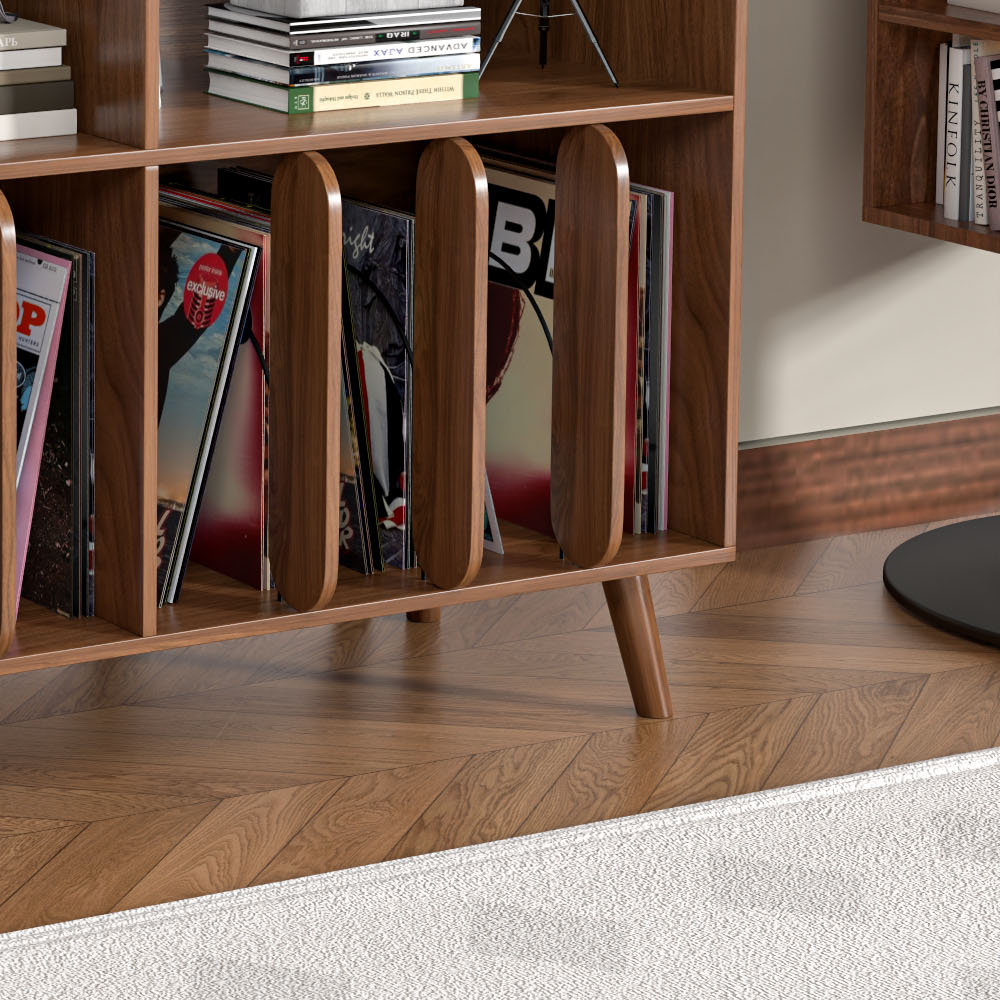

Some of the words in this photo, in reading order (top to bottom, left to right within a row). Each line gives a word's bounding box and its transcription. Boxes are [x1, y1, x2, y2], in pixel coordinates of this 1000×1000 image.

[386, 31, 410, 39] IRAQ
[373, 48, 403, 57] AJAX
[408, 43, 468, 54] ADVANCED
[977, 80, 988, 98] BY
[946, 83, 959, 187] KINFOLK
[980, 100, 994, 171] CHRISTIAN
[974, 120, 984, 218] TRANQUILITY
[986, 175, 998, 208] DIOR
[187, 280, 225, 302] exclusive
